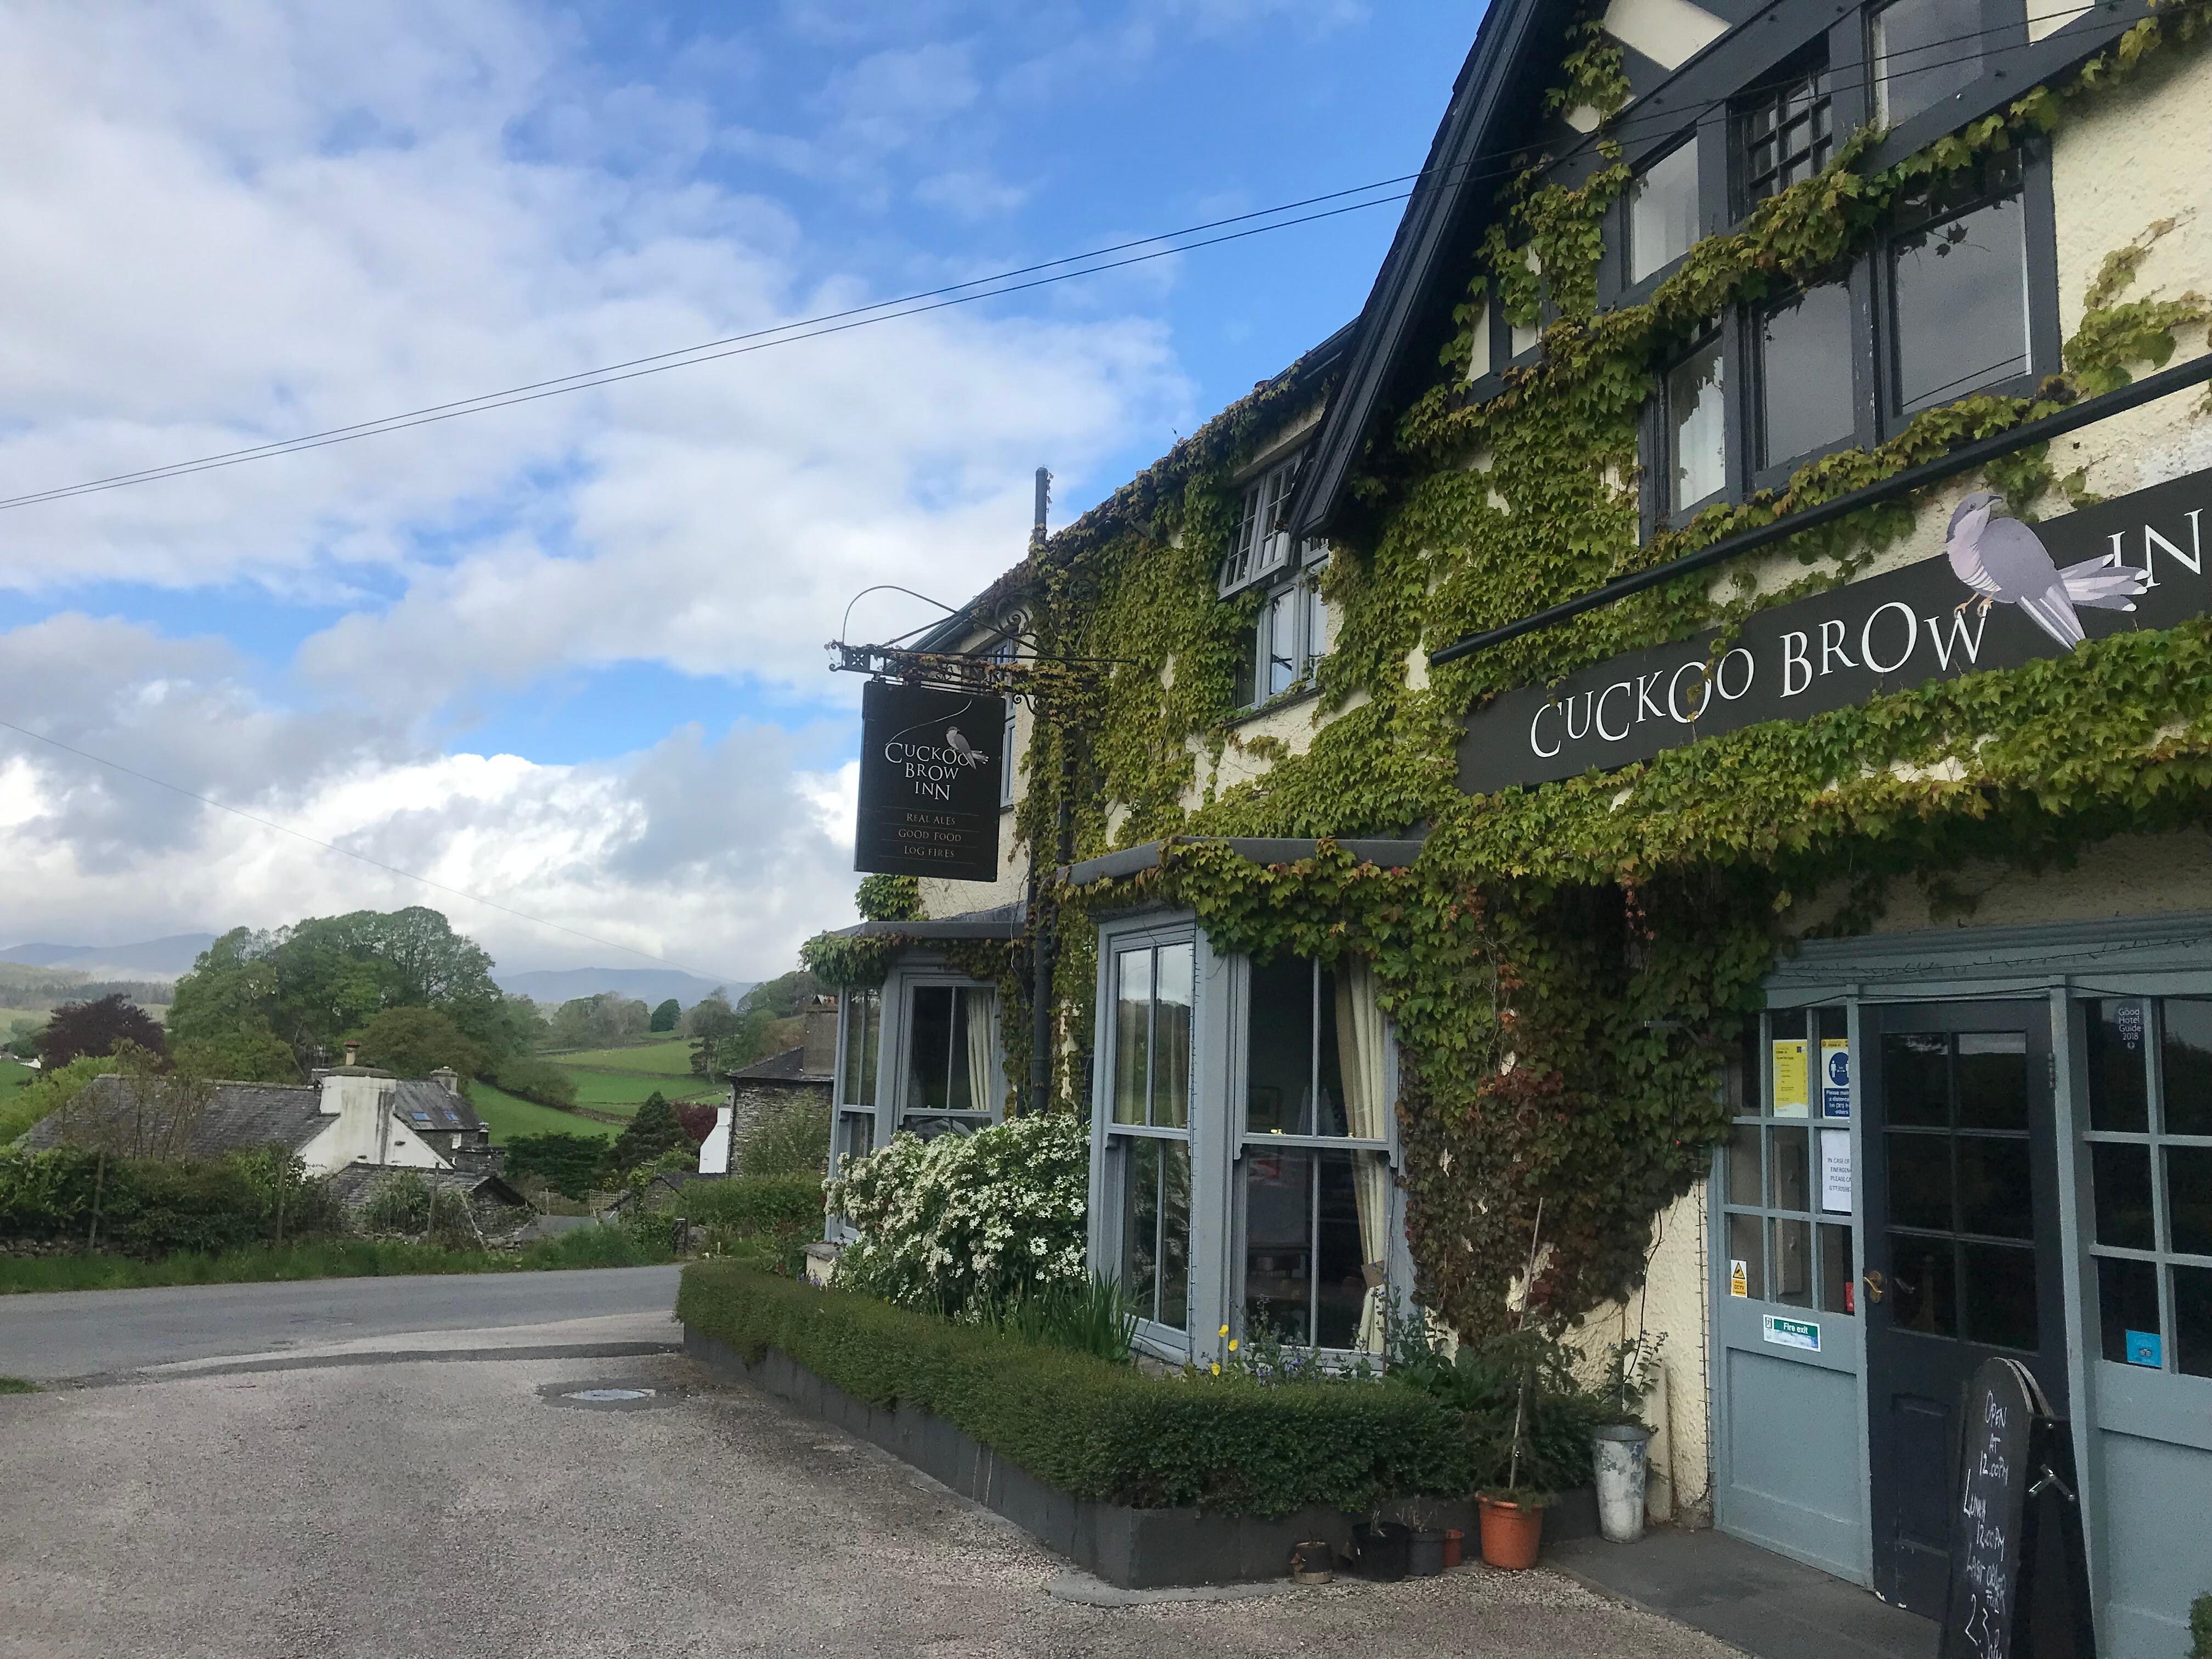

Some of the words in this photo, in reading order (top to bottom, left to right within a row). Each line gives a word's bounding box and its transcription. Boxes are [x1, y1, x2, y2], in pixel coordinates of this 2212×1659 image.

[1530, 647, 1754, 758] CUCKOO
[1780, 601, 1994, 698] BROW
[884, 742, 972, 767] CUCKOO
[905, 763, 959, 781] BROW
[915, 781, 951, 801] INN
[906, 812, 930, 823] REAL
[934, 815, 956, 826] ALES
[898, 828, 929, 839] GOOD
[934, 832, 962, 843] FOOD
[904, 845, 925, 856] LOG
[928, 848, 955, 859] FIRES
[1783, 1322, 1795, 1331] Fire
[1797, 1325, 1808, 1334] exit
